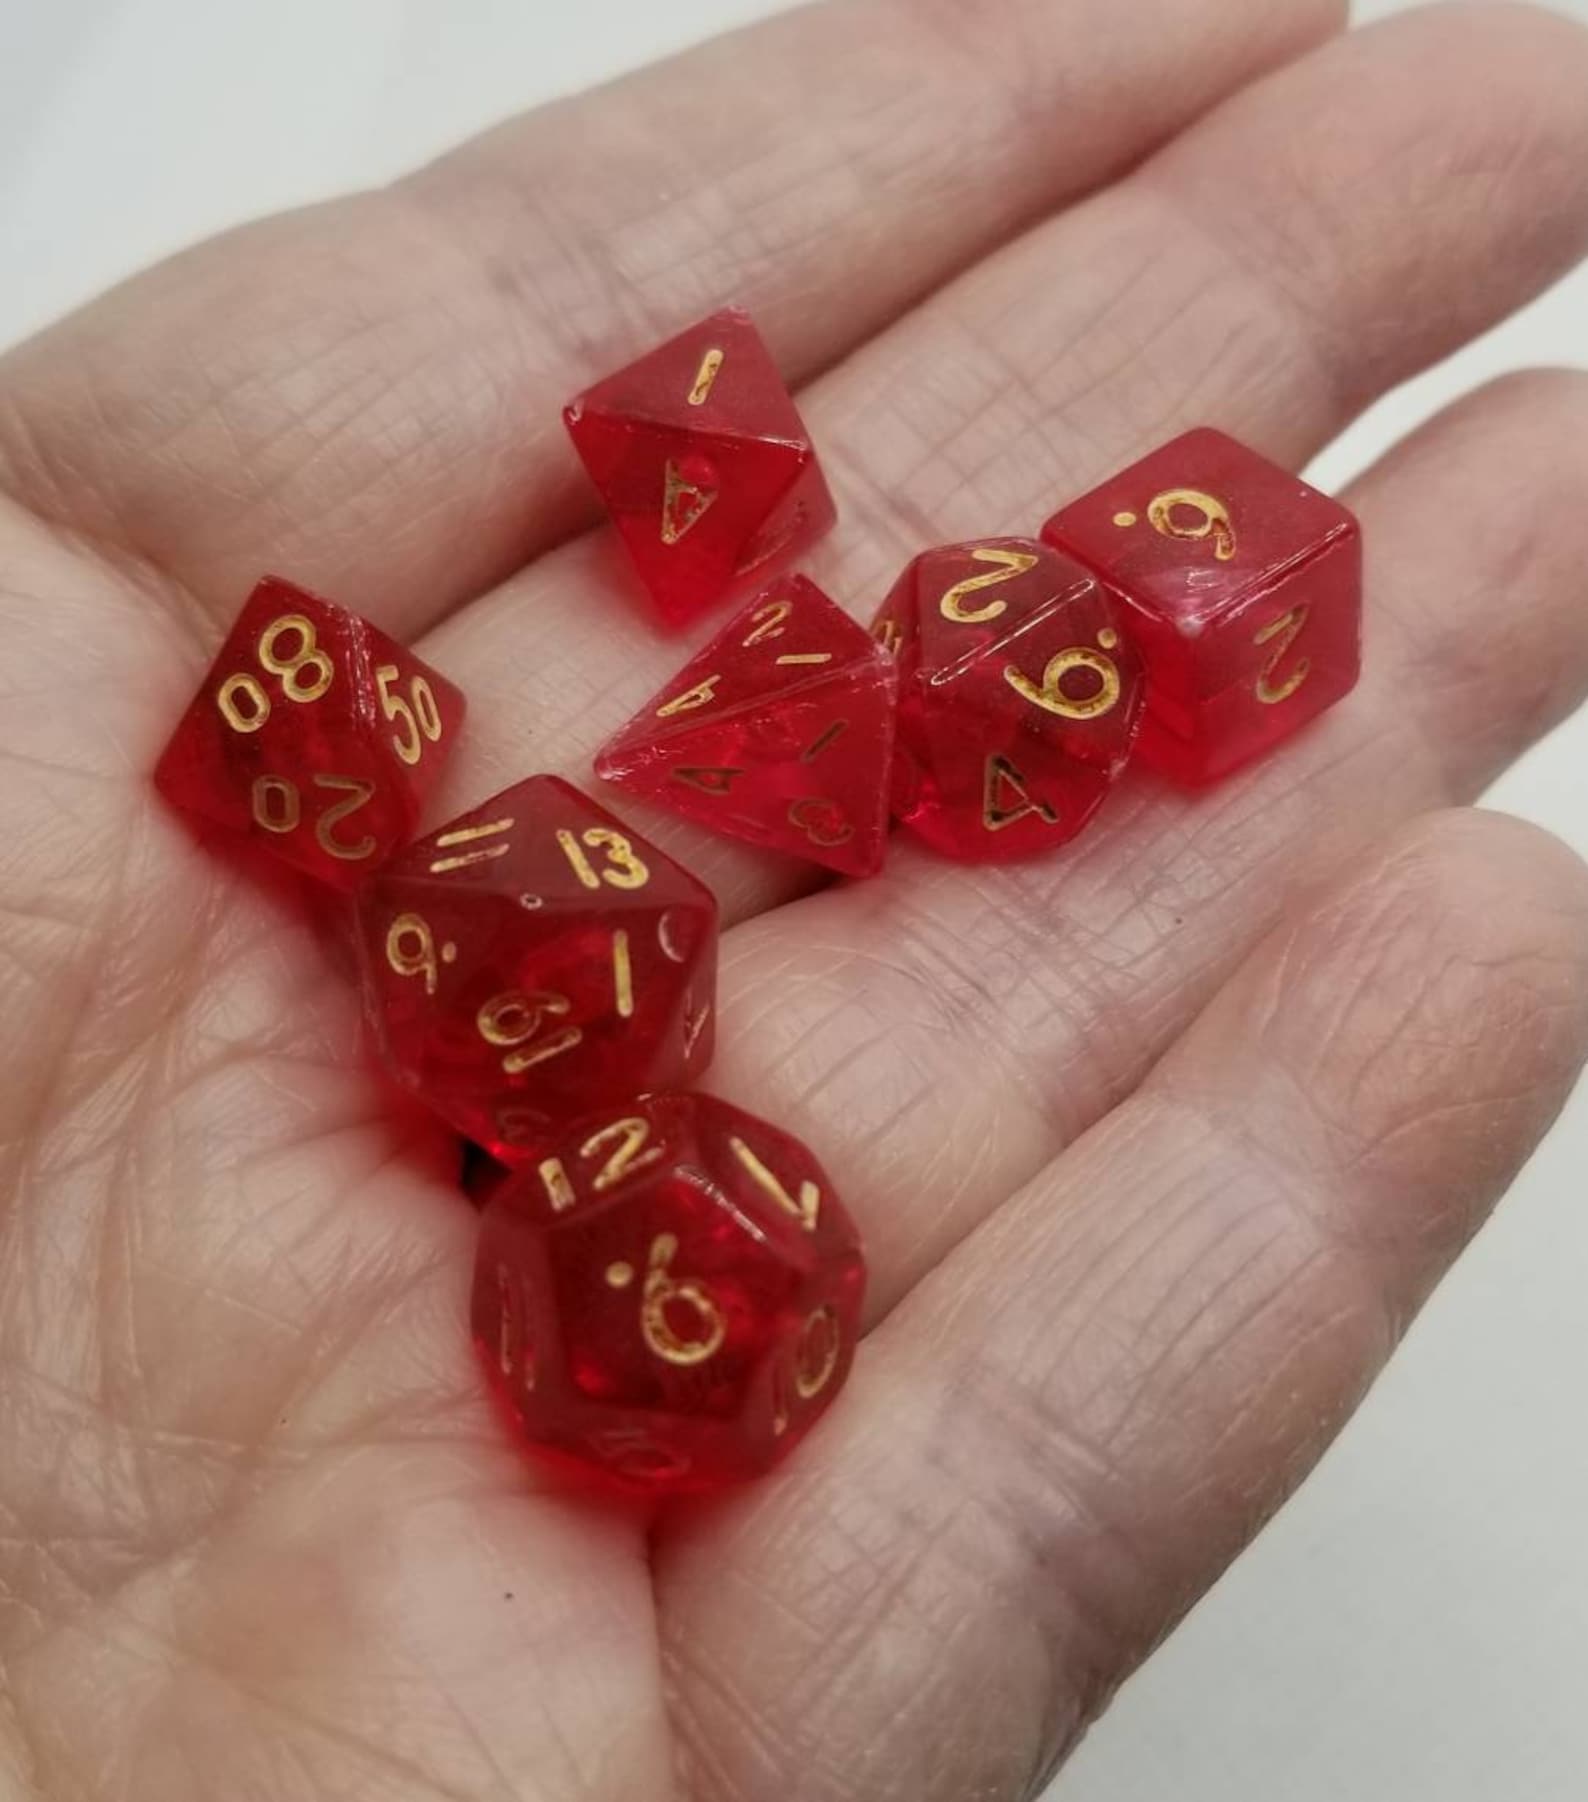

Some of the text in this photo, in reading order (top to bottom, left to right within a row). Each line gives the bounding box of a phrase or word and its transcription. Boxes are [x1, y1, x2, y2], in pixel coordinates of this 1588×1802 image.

[687, 349, 723, 405] 1
[661, 458, 719, 544] 4
[742, 600, 793, 647] 2
[940, 549, 1039, 623] 2
[1253, 600, 1311, 704] 2
[375, 664, 442, 764] 50
[656, 674, 722, 717] 4
[983, 754, 1059, 832] 4
[556, 828, 649, 889] 13
[613, 930, 634, 1017] 1
[538, 1117, 666, 1212] 12
